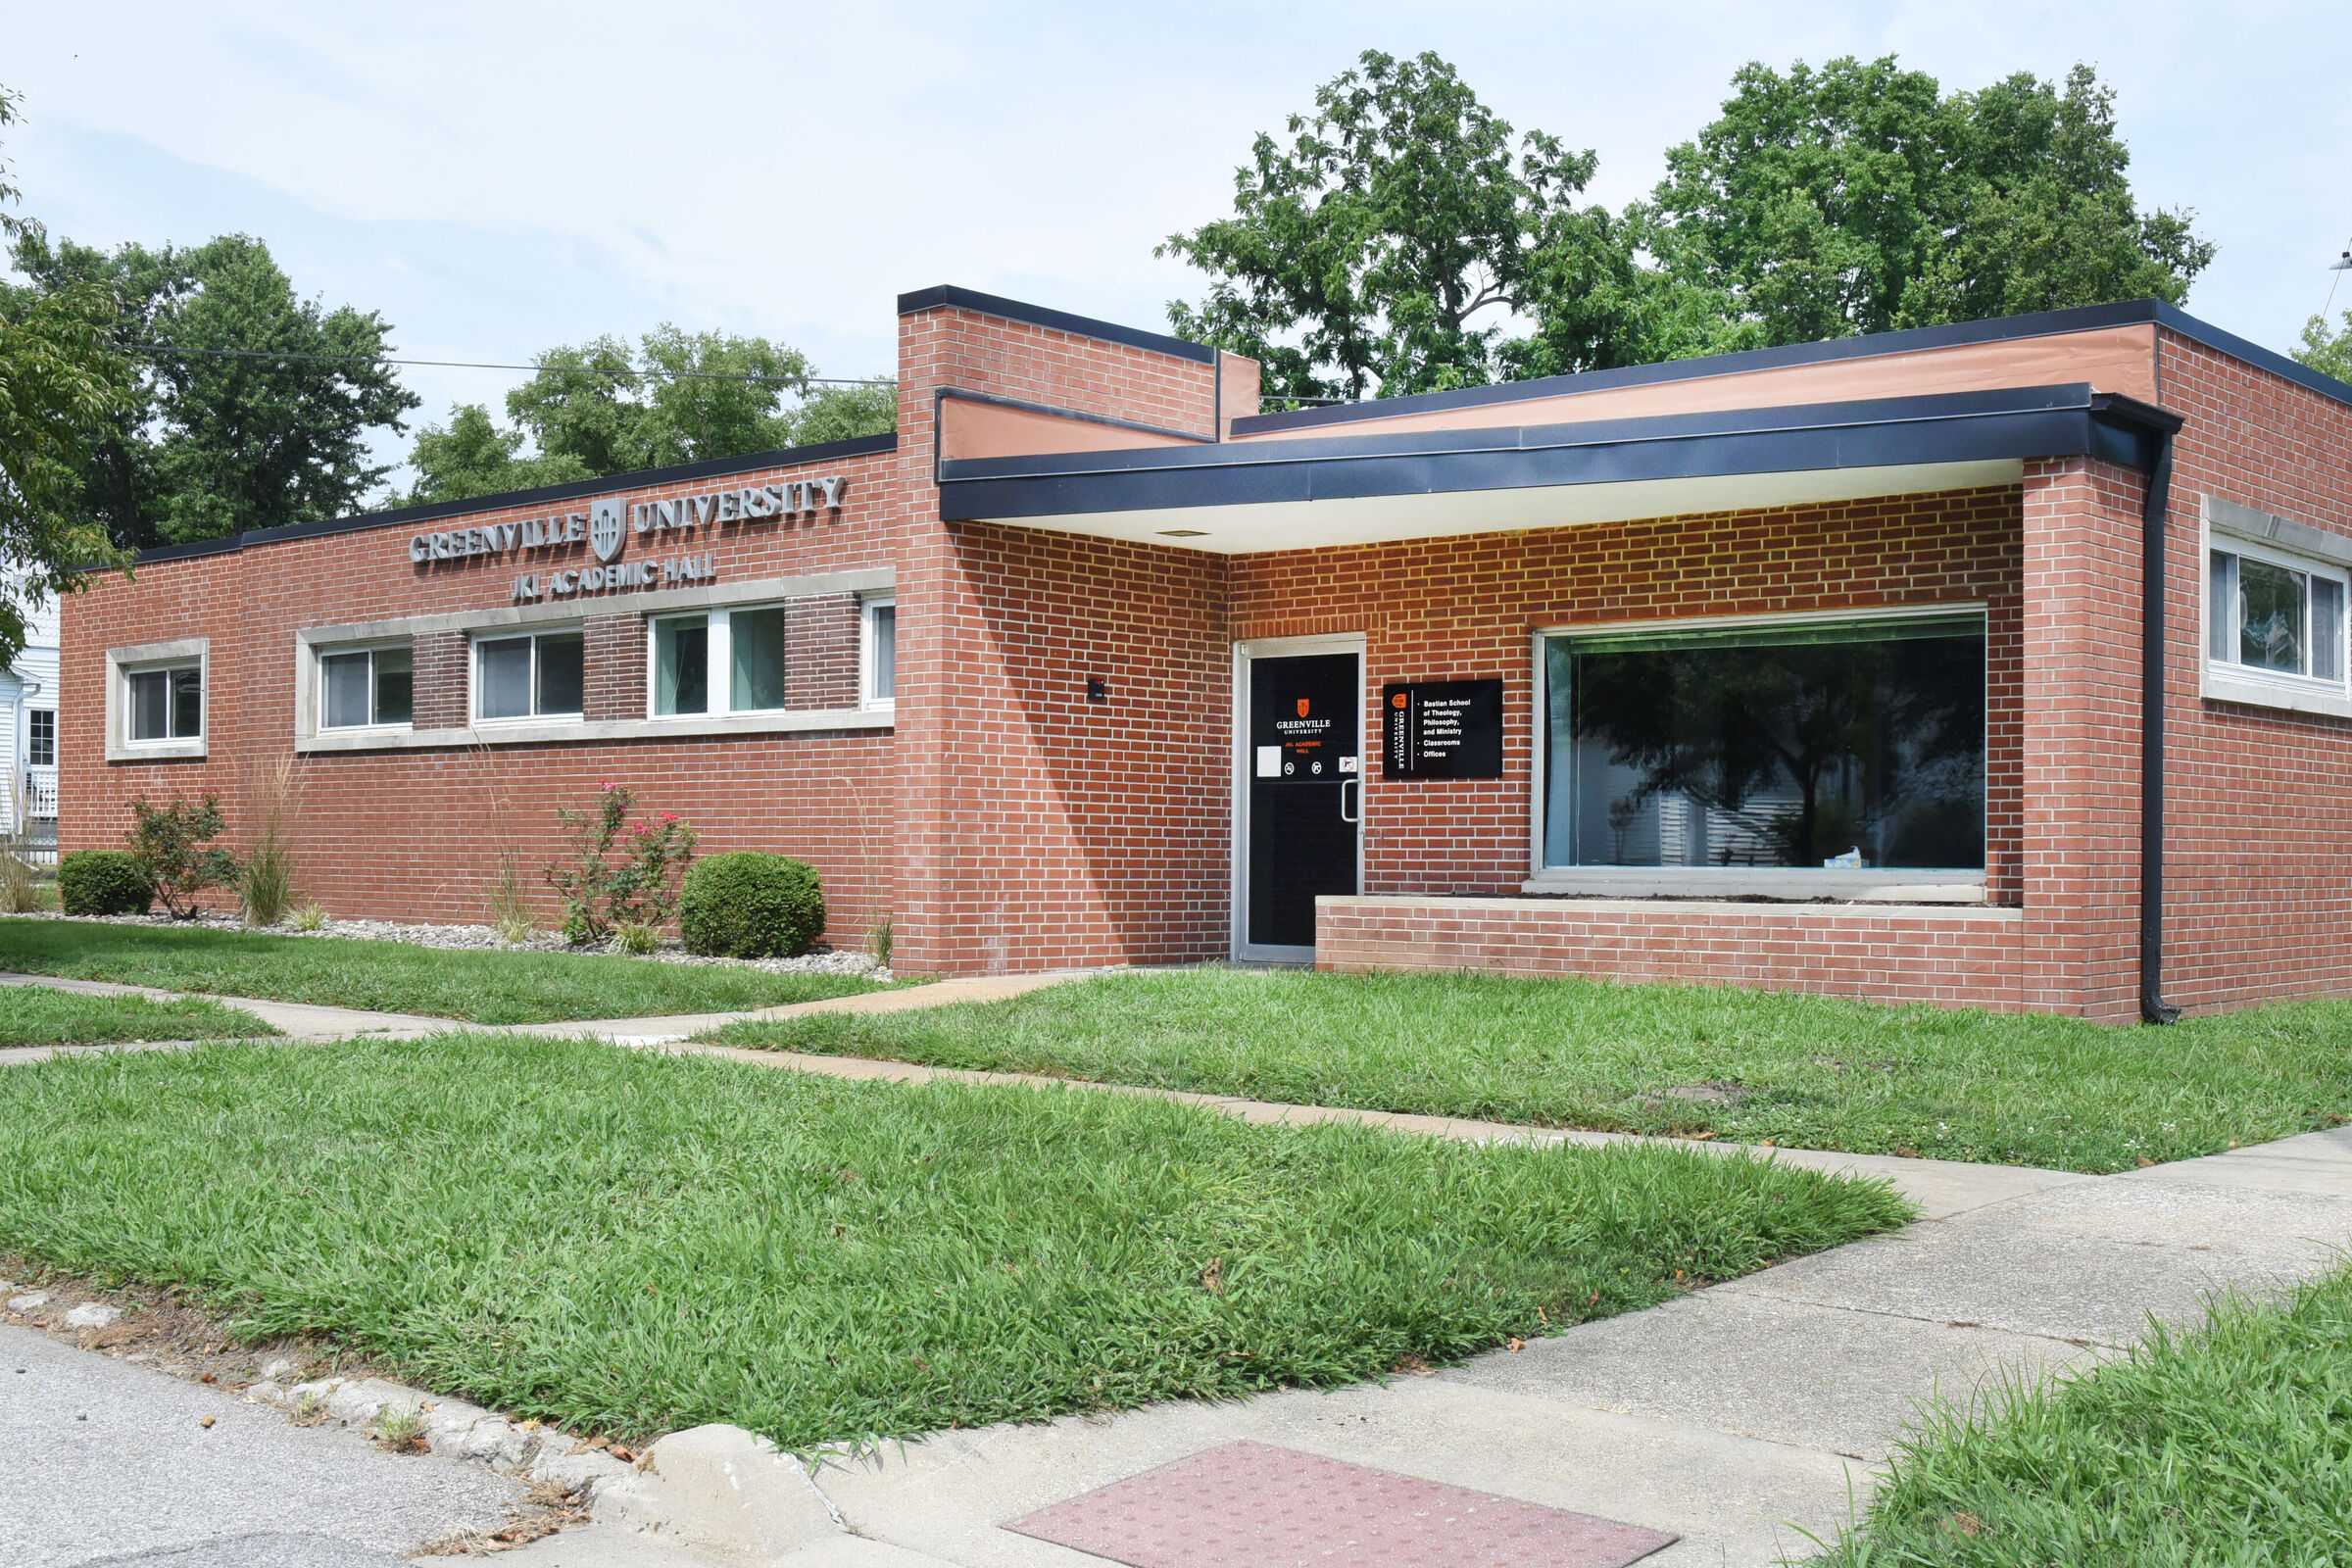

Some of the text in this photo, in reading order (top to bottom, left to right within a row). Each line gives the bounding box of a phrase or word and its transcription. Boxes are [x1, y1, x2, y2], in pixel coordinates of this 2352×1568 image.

[409, 475, 846, 563] GREENVILLE UNIVERSITY
[512, 553, 716, 598] JKL ACADEMIC HALL
[1276, 719, 1331, 729] GREENVILLE
